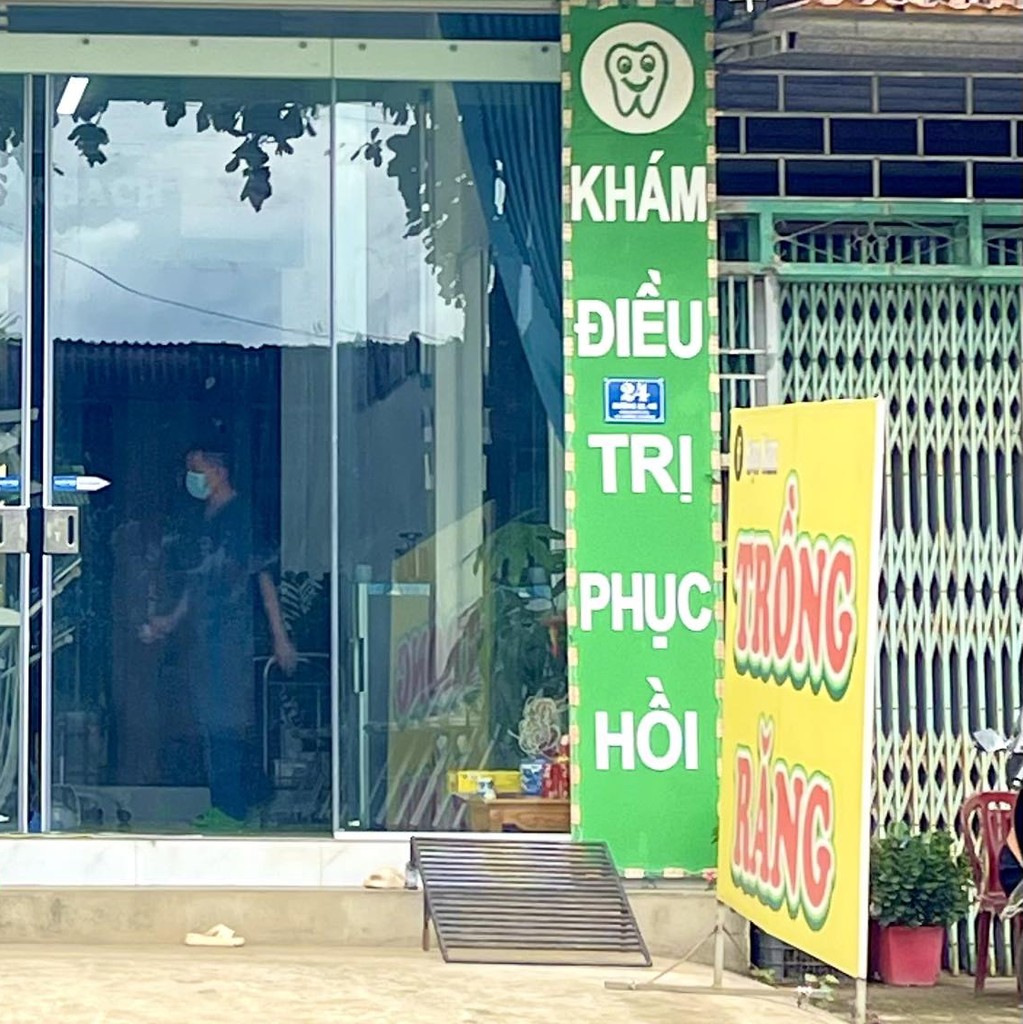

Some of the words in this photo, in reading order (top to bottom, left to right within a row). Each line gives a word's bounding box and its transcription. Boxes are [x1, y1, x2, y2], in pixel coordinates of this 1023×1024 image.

[571, 150, 708, 222] KHÁM
[573, 269, 704, 359] ĐIỀU
[587, 433, 693, 504] TRỊ
[580, 572, 714, 650] PHỤC
[594, 676, 699, 771] HỒI
[733, 723, 834, 920] RĂNG
